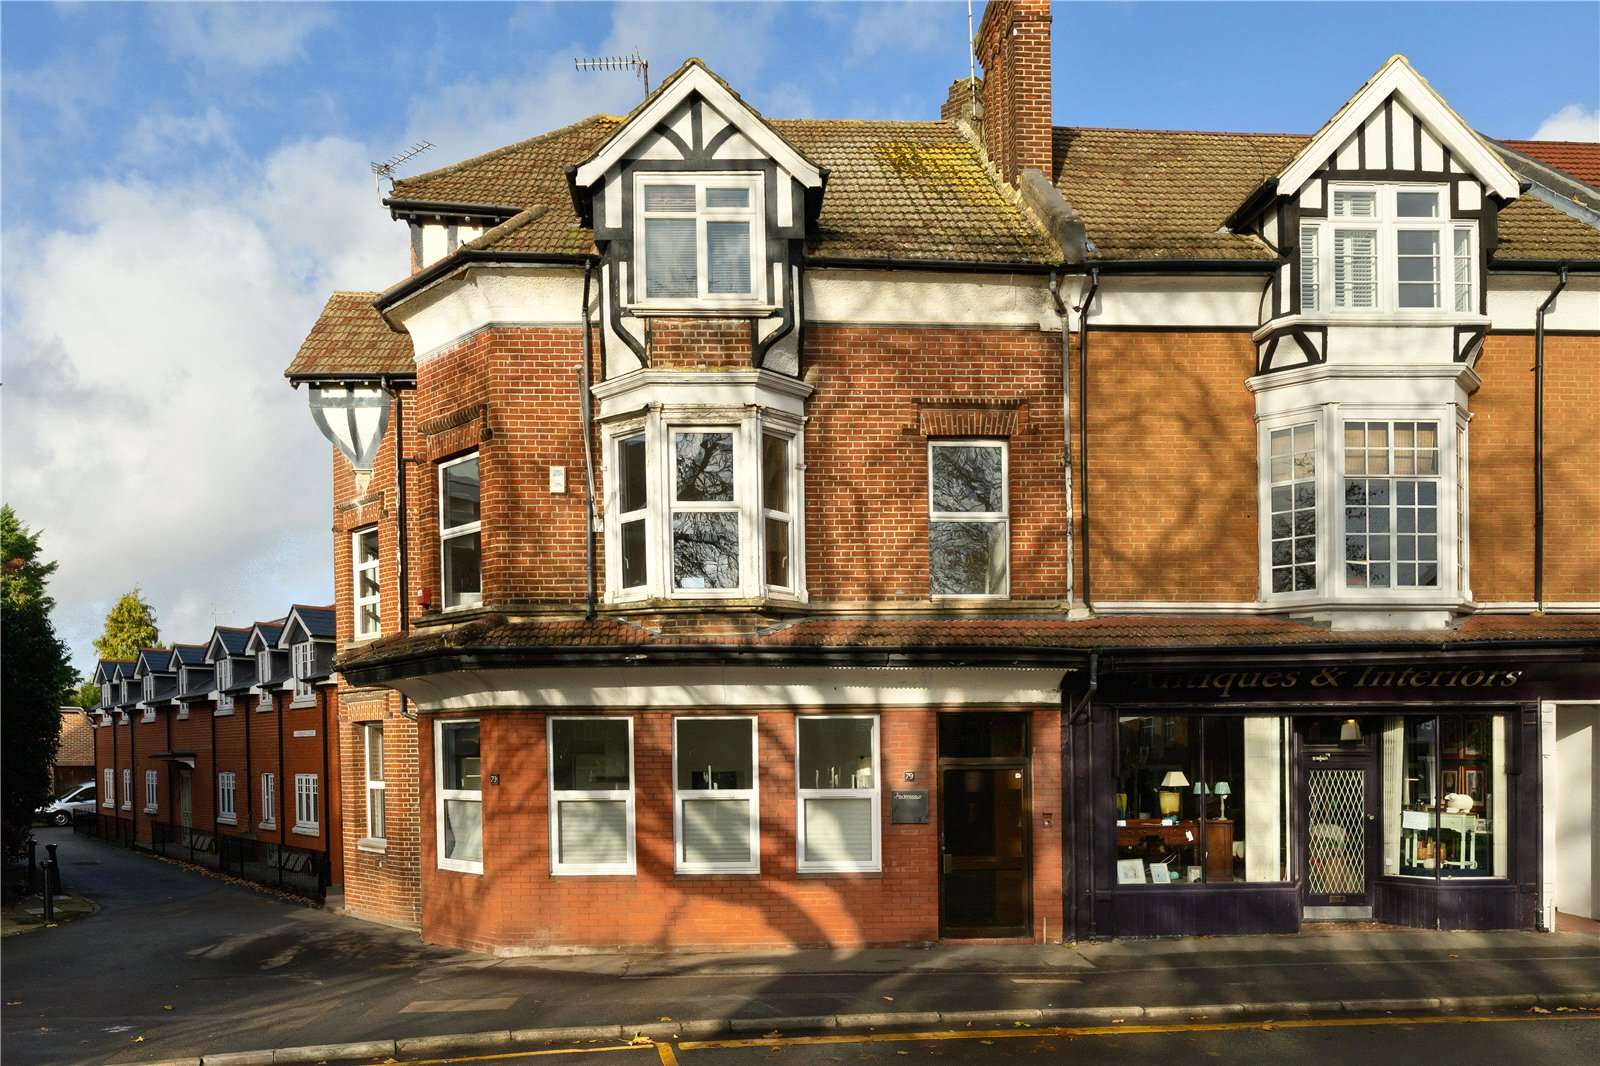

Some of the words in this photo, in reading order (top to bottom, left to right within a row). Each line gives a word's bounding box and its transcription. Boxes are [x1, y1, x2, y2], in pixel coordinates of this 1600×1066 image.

[1140, 669, 1297, 698] ntiques
[1310, 665, 1343, 687] &
[1353, 666, 1524, 688] Interiors
